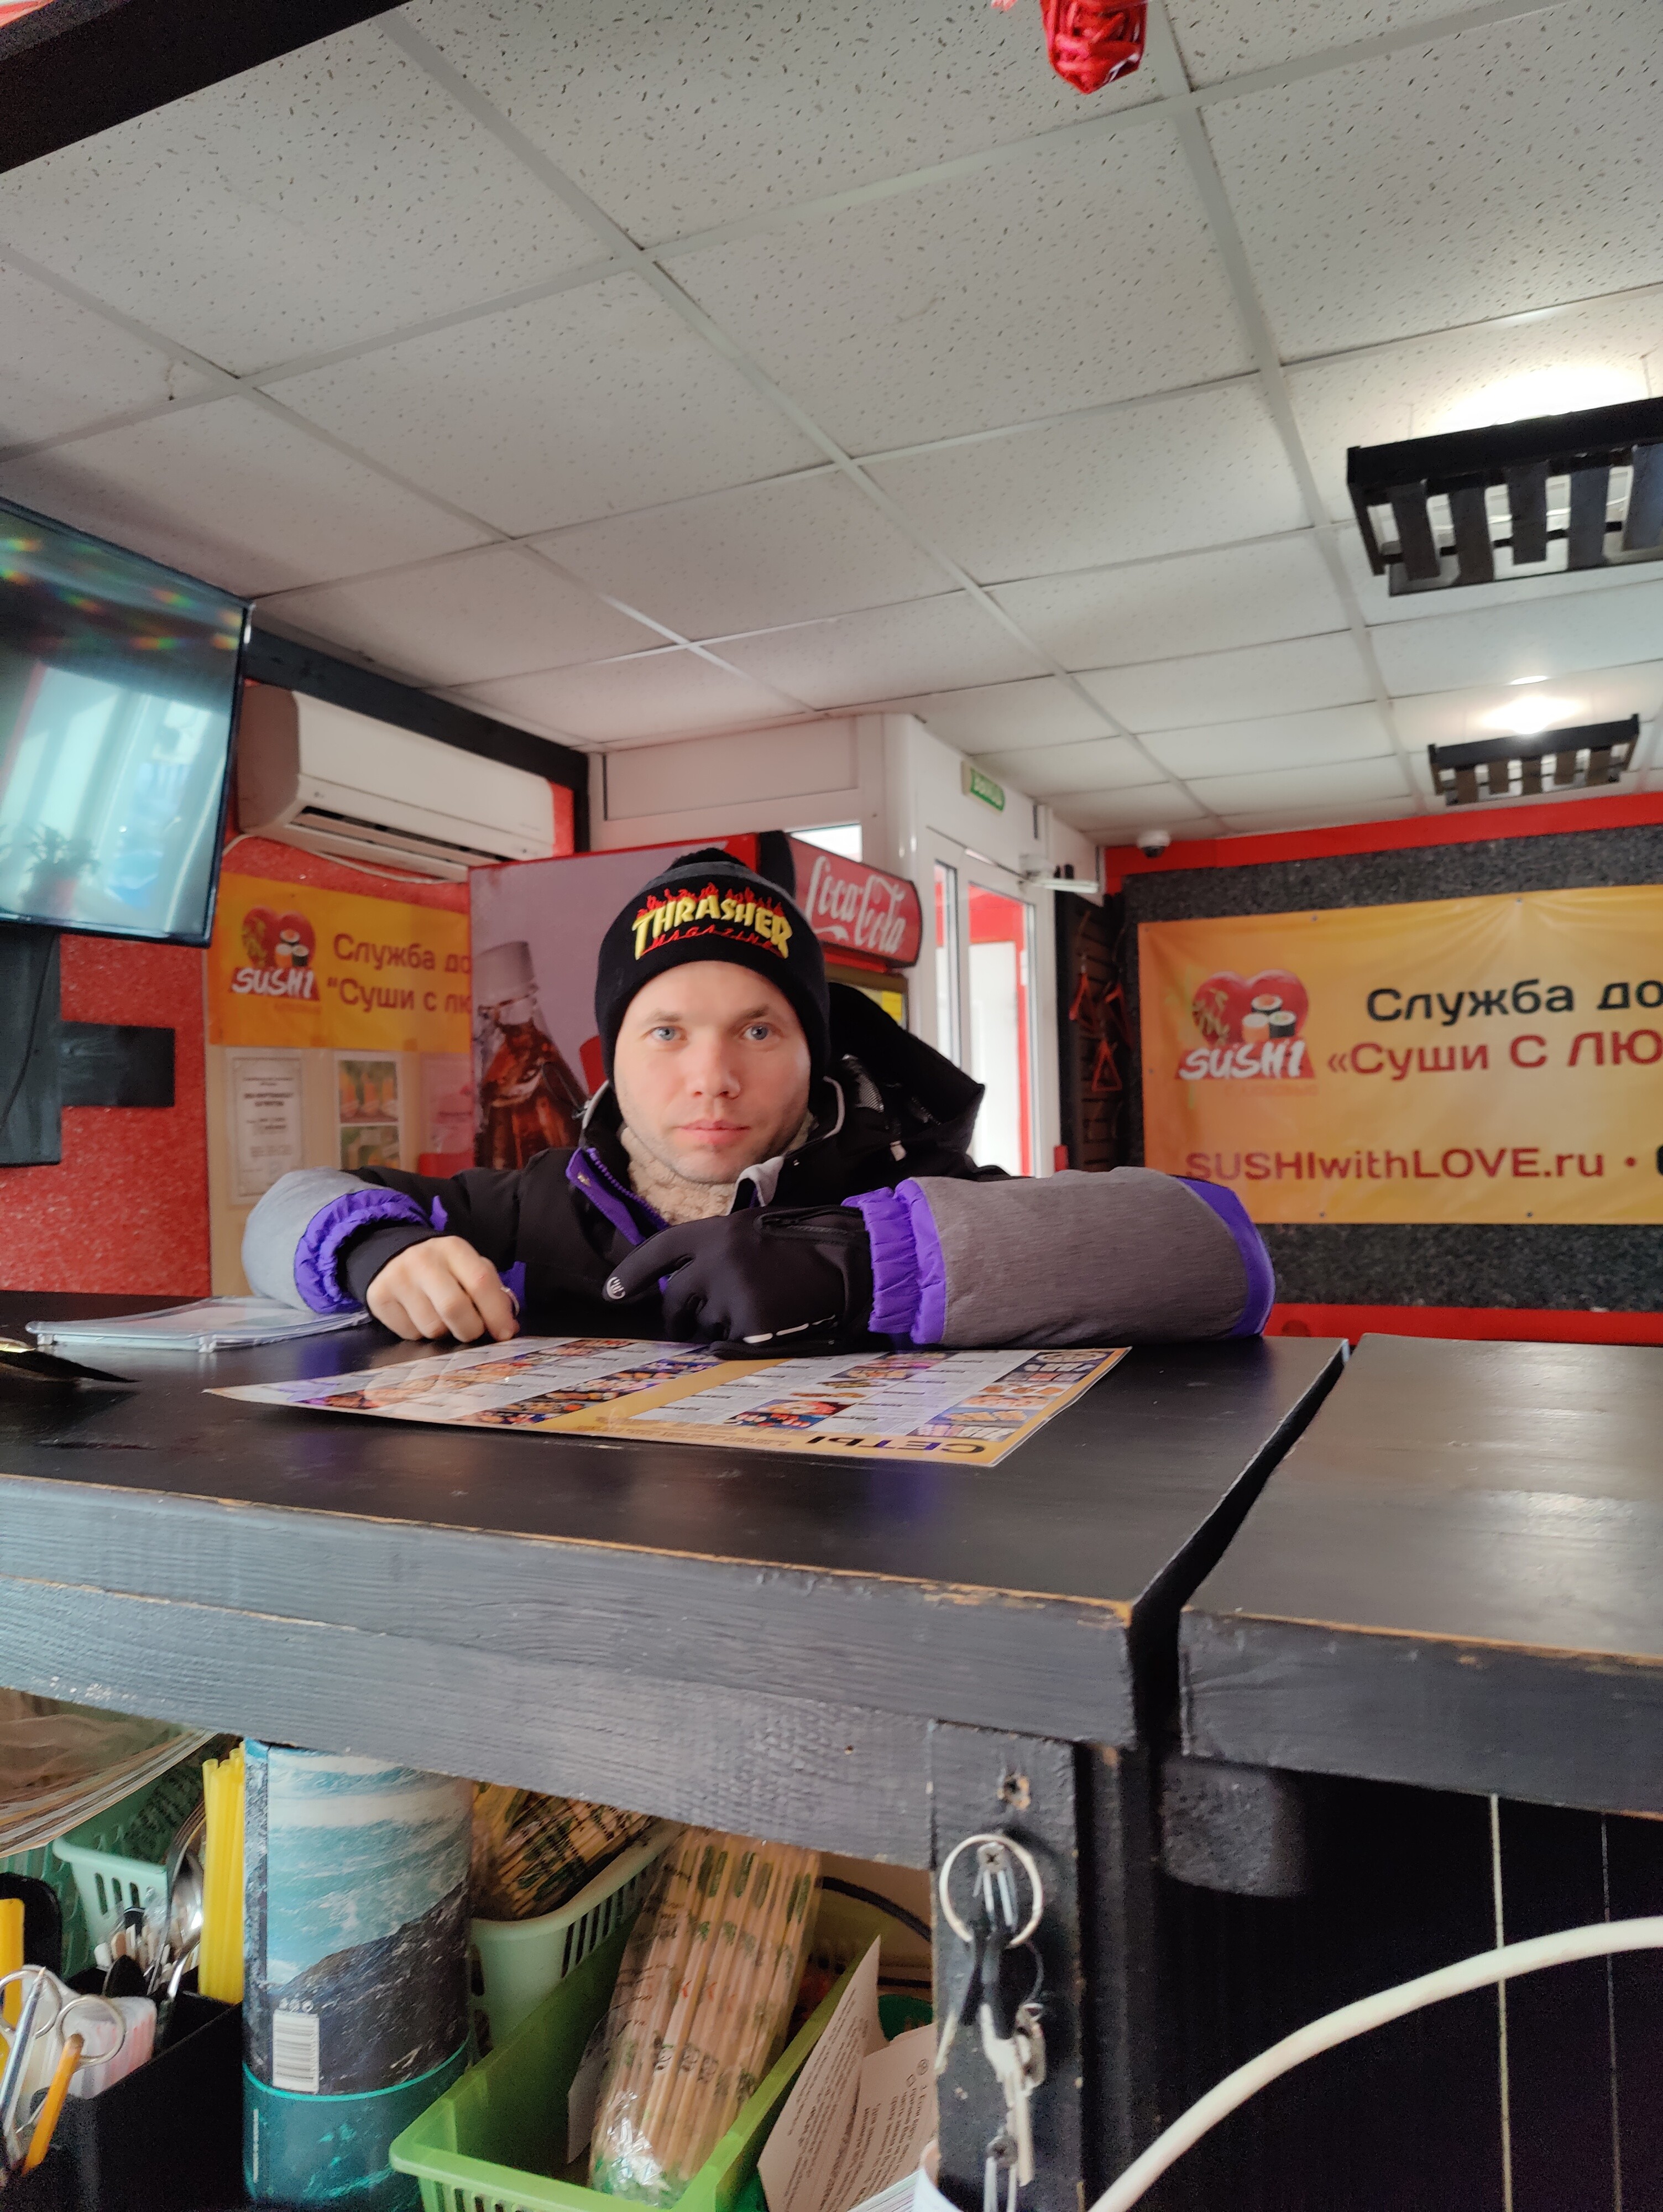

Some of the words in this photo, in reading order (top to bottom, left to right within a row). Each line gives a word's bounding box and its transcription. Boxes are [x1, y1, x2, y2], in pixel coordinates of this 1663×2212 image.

[631, 894, 793, 961] THRASHER
[333, 933, 436, 971] Служба
[232, 967, 314, 999] SUSHI
[1367, 979, 1575, 1027] Служба
[1597, 980, 1663, 1010] до
[1178, 1039, 1305, 1081] SUSHI
[1327, 1042, 1489, 1081] «Суши
[1510, 1035, 1547, 1068] С
[1567, 1029, 1663, 1067] ЛЮ
[1186, 1147, 1604, 1180] SUSHIwithLOVE.ru
[805, 1436, 986, 1453] СЕТЫ
